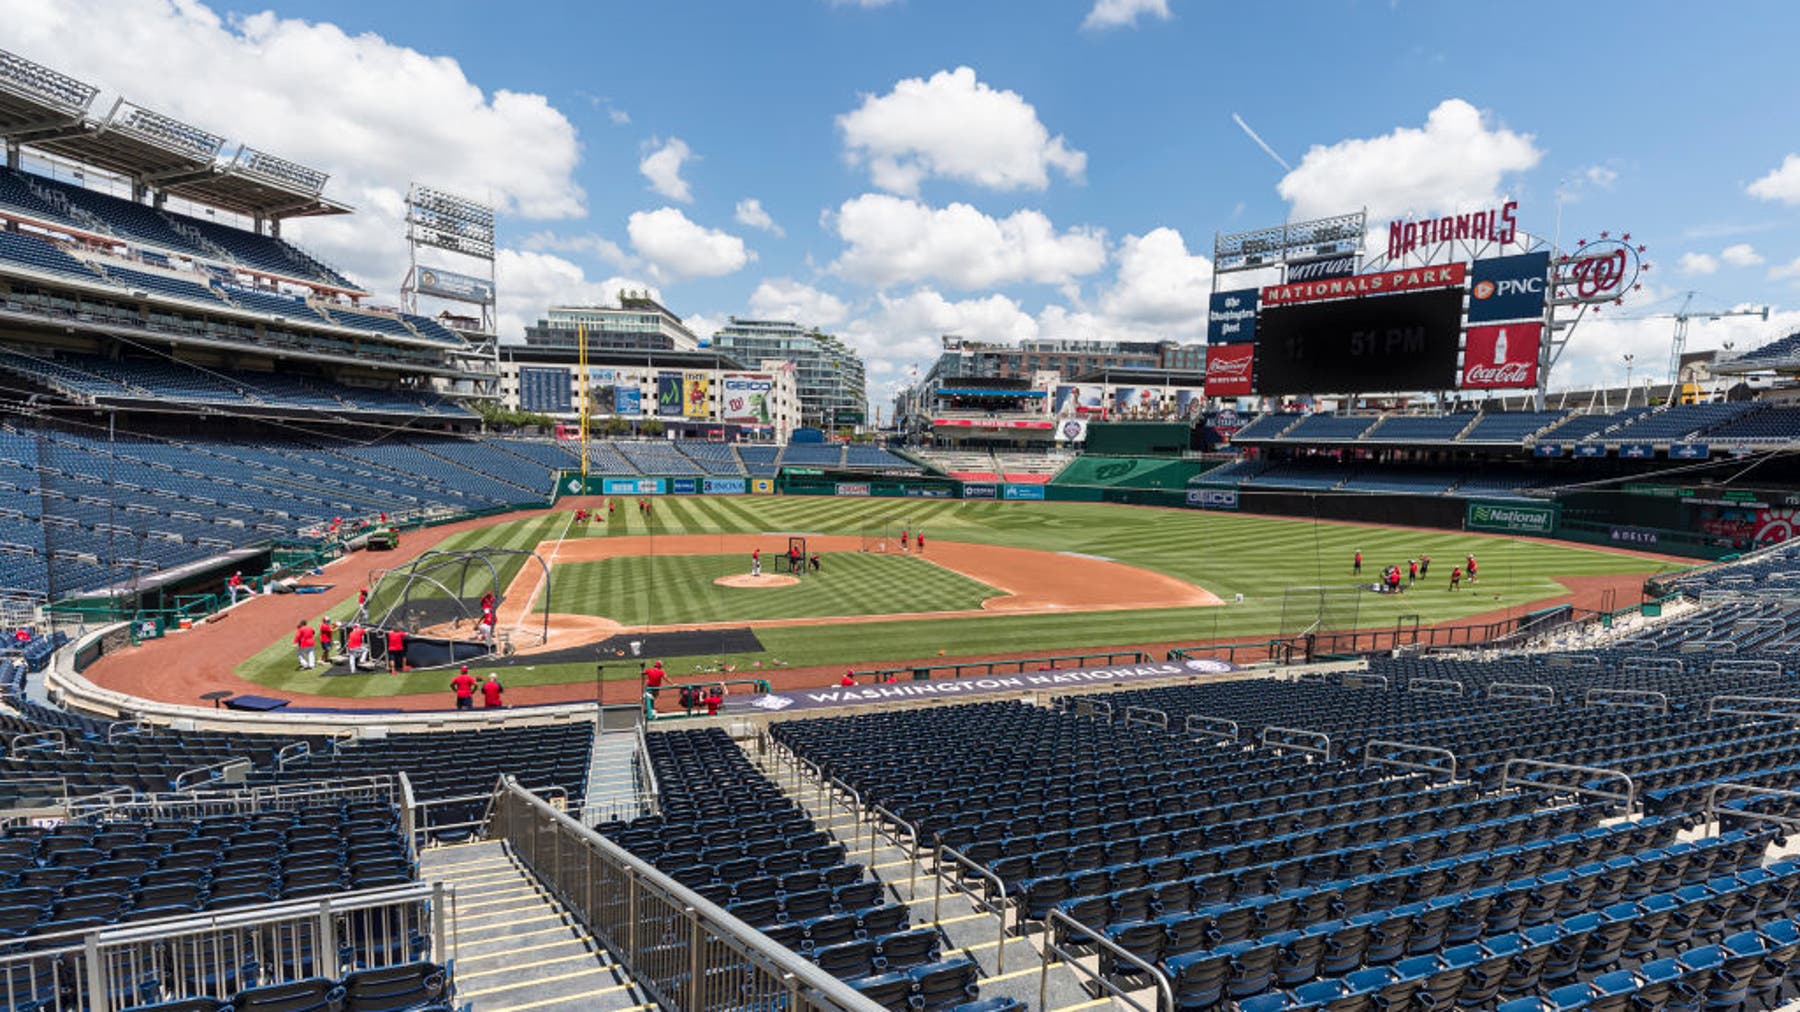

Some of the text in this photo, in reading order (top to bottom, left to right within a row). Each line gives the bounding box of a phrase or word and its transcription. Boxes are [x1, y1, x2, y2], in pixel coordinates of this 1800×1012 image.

[1388, 201, 1518, 260] NATIONALS
[1268, 268, 1453, 301] NATIONALS PARK
[1497, 277, 1543, 297] PNC
[1384, 325, 1426, 356] PM
[725, 381, 771, 391] GEICO
[1188, 491, 1235, 505] GEICO
[1490, 509, 1547, 525] National
[1622, 534, 1657, 543] DELTA
[808, 665, 1182, 703] WASHINGTON NATIONALS
